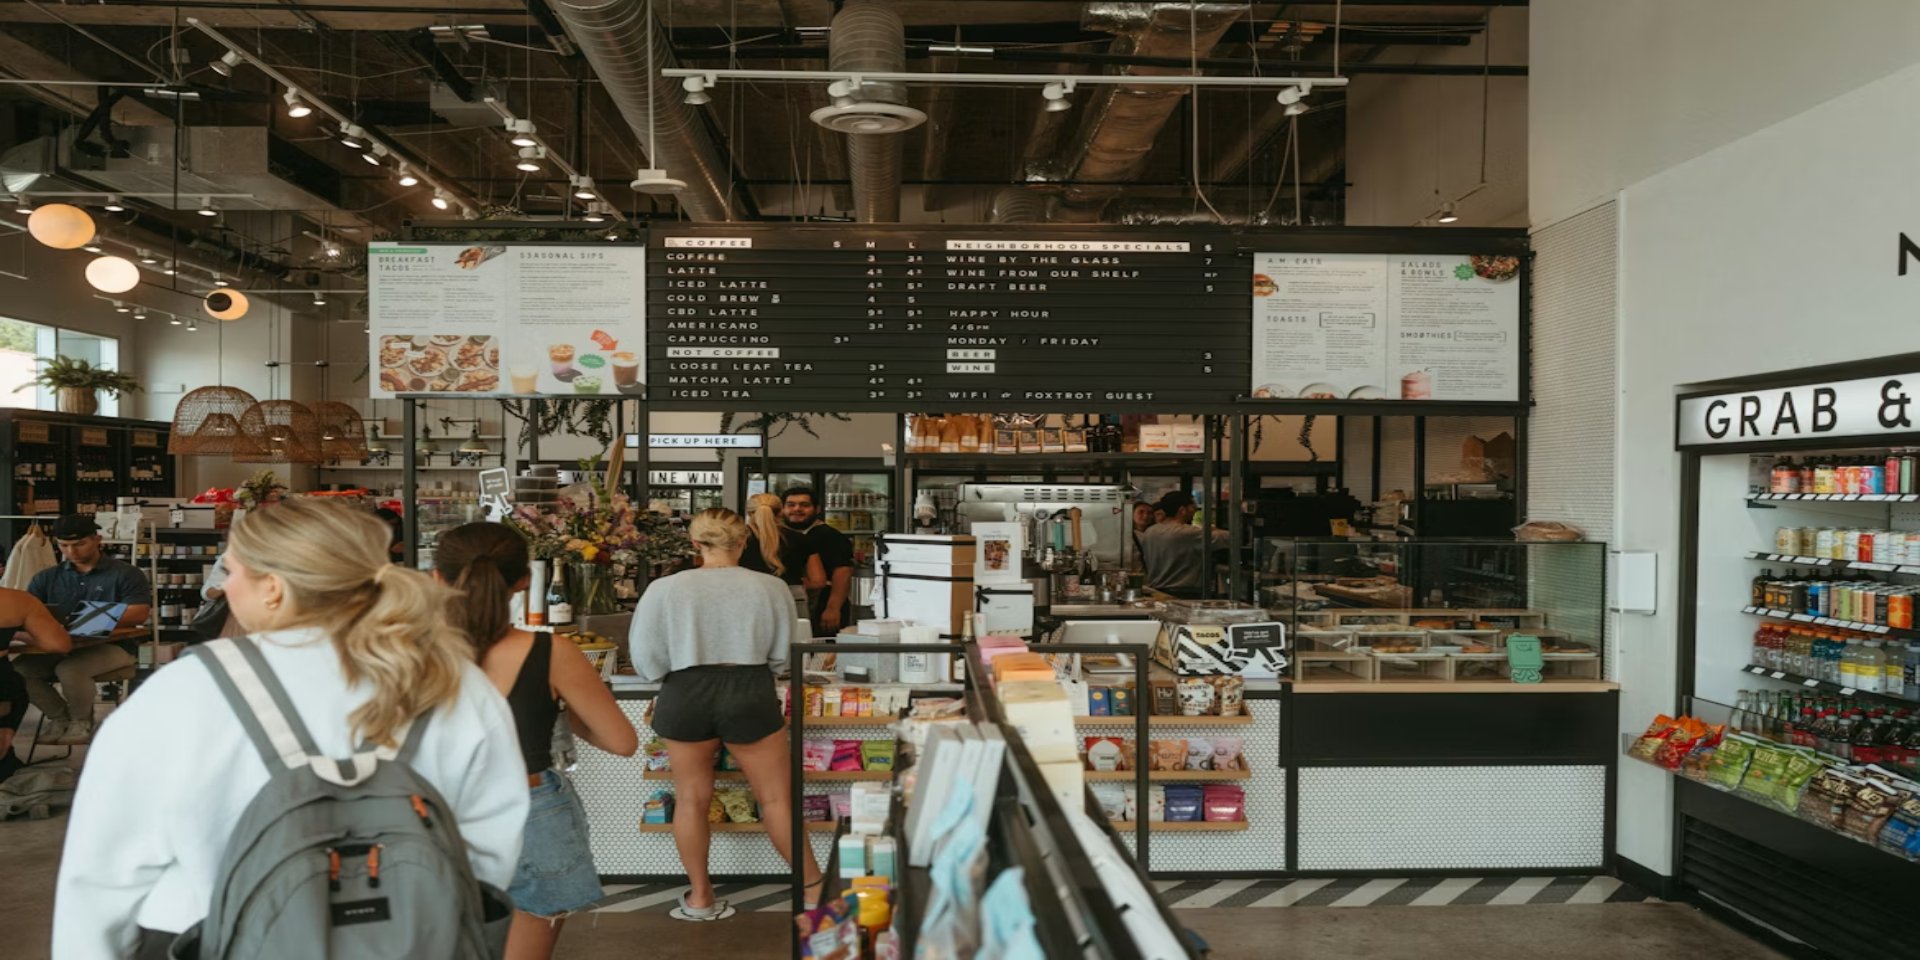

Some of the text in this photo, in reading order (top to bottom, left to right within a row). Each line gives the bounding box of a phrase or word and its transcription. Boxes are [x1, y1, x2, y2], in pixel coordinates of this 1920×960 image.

[668, 335, 769, 343] CAPPUCCINO
[1705, 379, 1911, 439] GRAB &
